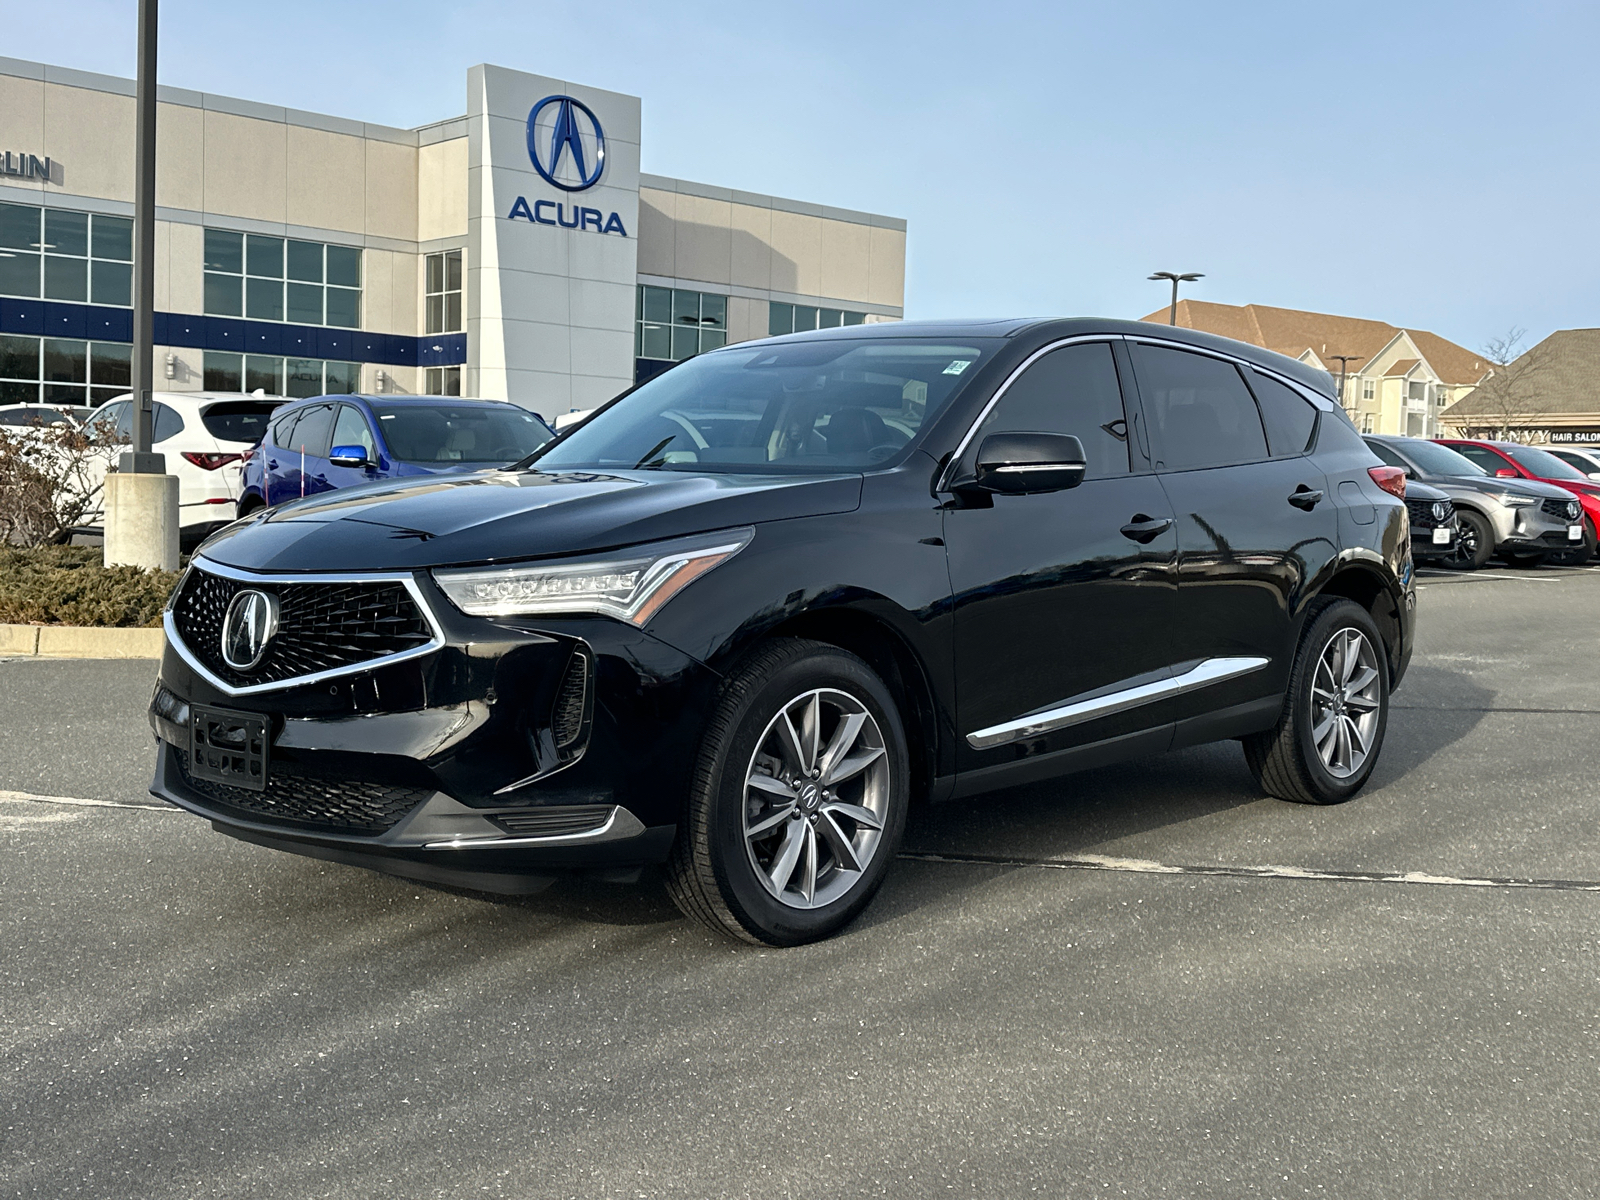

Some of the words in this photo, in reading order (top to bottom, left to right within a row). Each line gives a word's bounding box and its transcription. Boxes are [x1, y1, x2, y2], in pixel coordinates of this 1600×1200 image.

[0, 151, 50, 180] LIN
[508, 196, 627, 237] ACURA
[1552, 433, 1573, 442] HAIR
